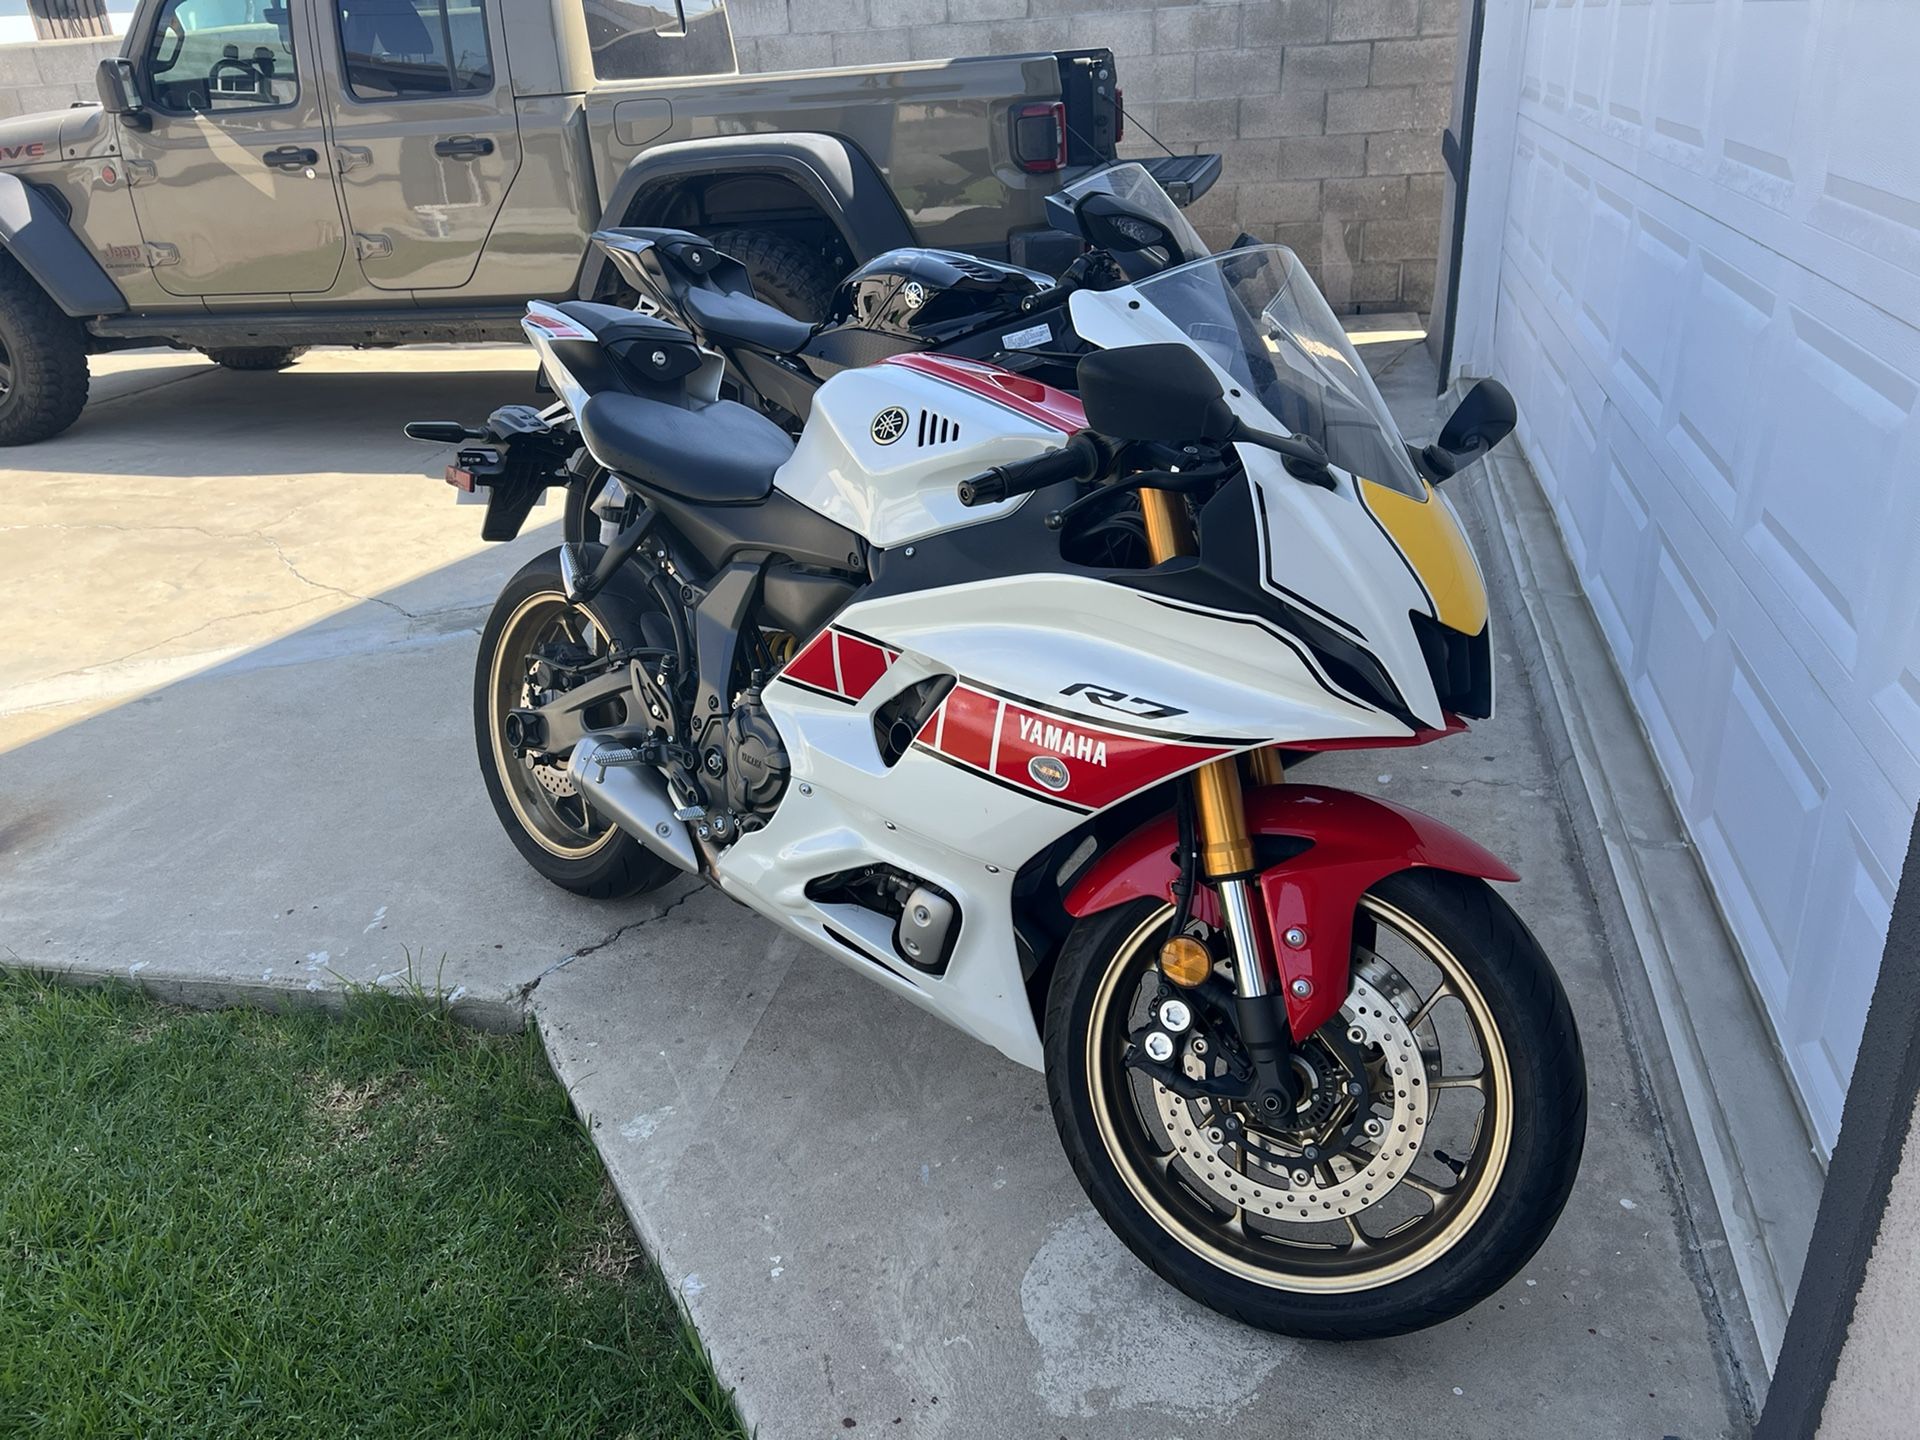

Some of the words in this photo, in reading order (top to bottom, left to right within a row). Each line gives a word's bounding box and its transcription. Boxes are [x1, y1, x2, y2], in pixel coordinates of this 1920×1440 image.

[105, 243, 141, 261] Jeep
[1059, 683, 1189, 719] R7
[1019, 714, 1107, 768] YAMAHA
